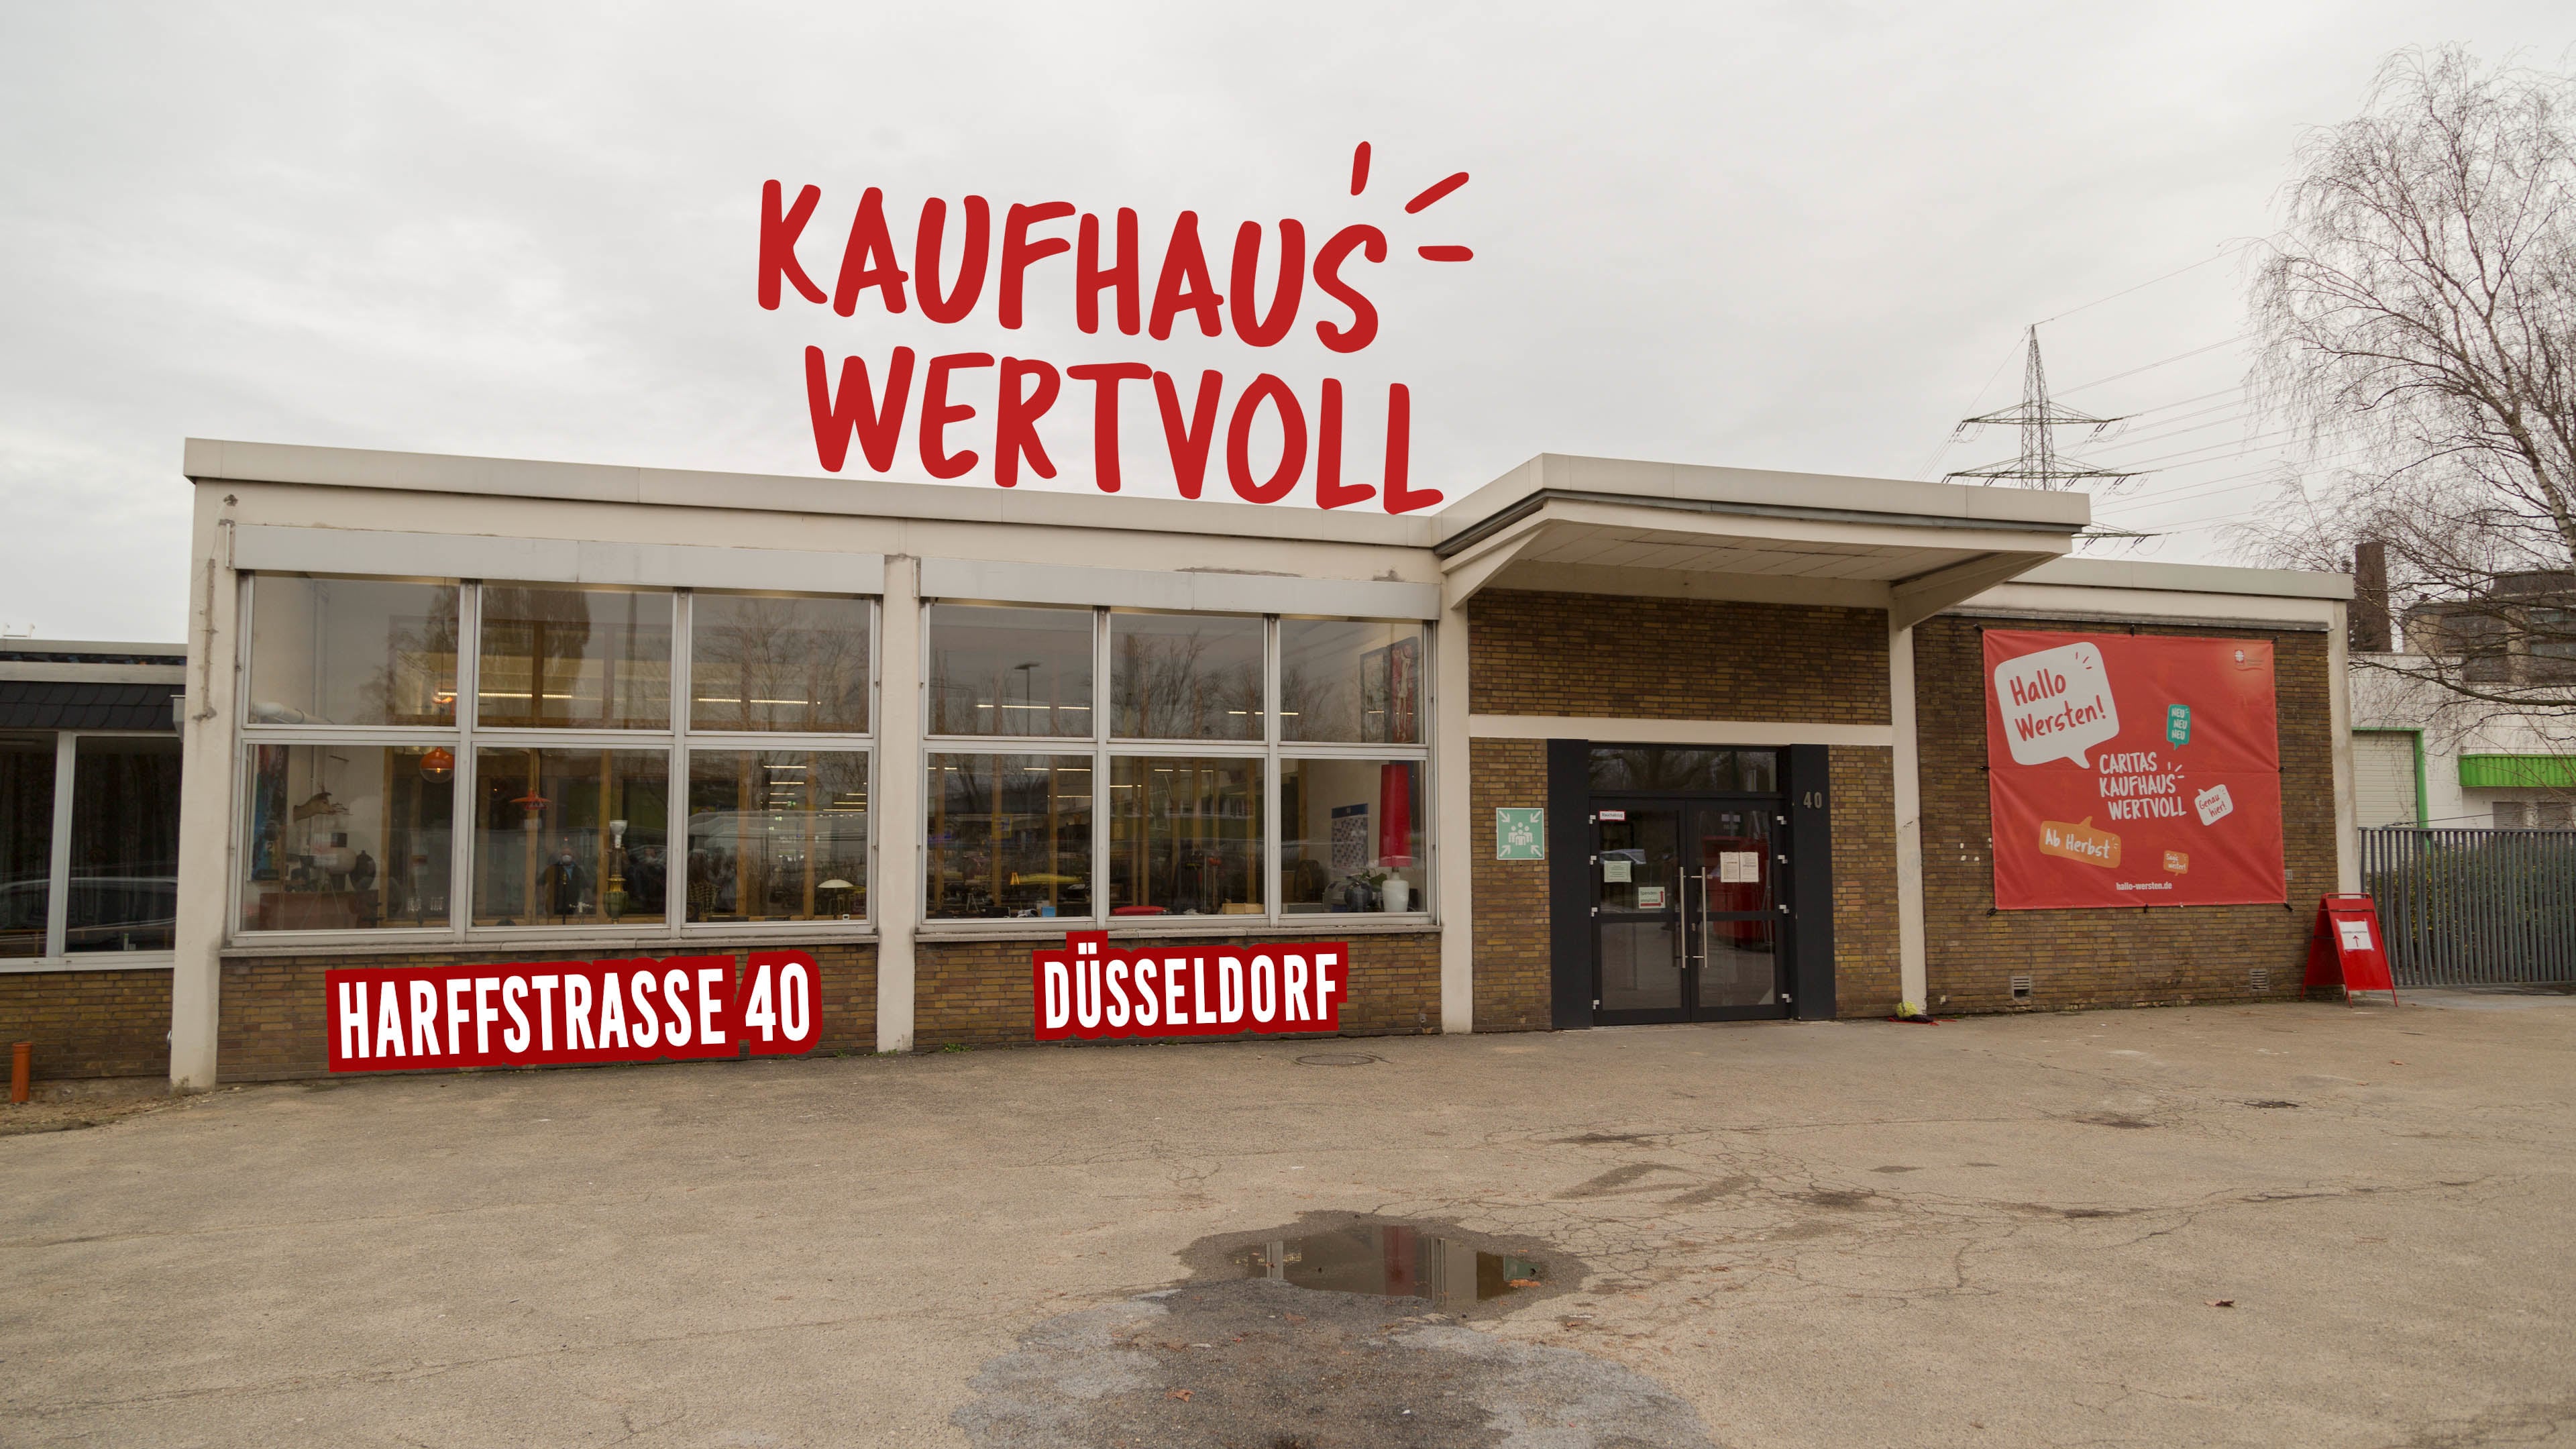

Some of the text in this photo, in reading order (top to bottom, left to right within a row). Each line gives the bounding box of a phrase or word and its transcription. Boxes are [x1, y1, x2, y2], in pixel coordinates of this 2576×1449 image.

[2010, 668, 2066, 706] Hallo
[2015, 694, 2106, 741] Wersten!
[2171, 708, 2185, 718] NEU
[2174, 719, 2187, 729] NEU
[2171, 729, 2186, 740] NEU
[2099, 751, 2157, 774] CARITAS
[2099, 773, 2176, 798] KAUFHAUS
[1803, 792, 1822, 808] 40
[2108, 796, 2187, 820] WERTVOLL
[2199, 794, 2220, 810] Genau
[2208, 801, 2227, 817] hier!
[2045, 828, 2110, 859] Ab Herbst
[2116, 881, 2172, 890] hallo-wersten.de
